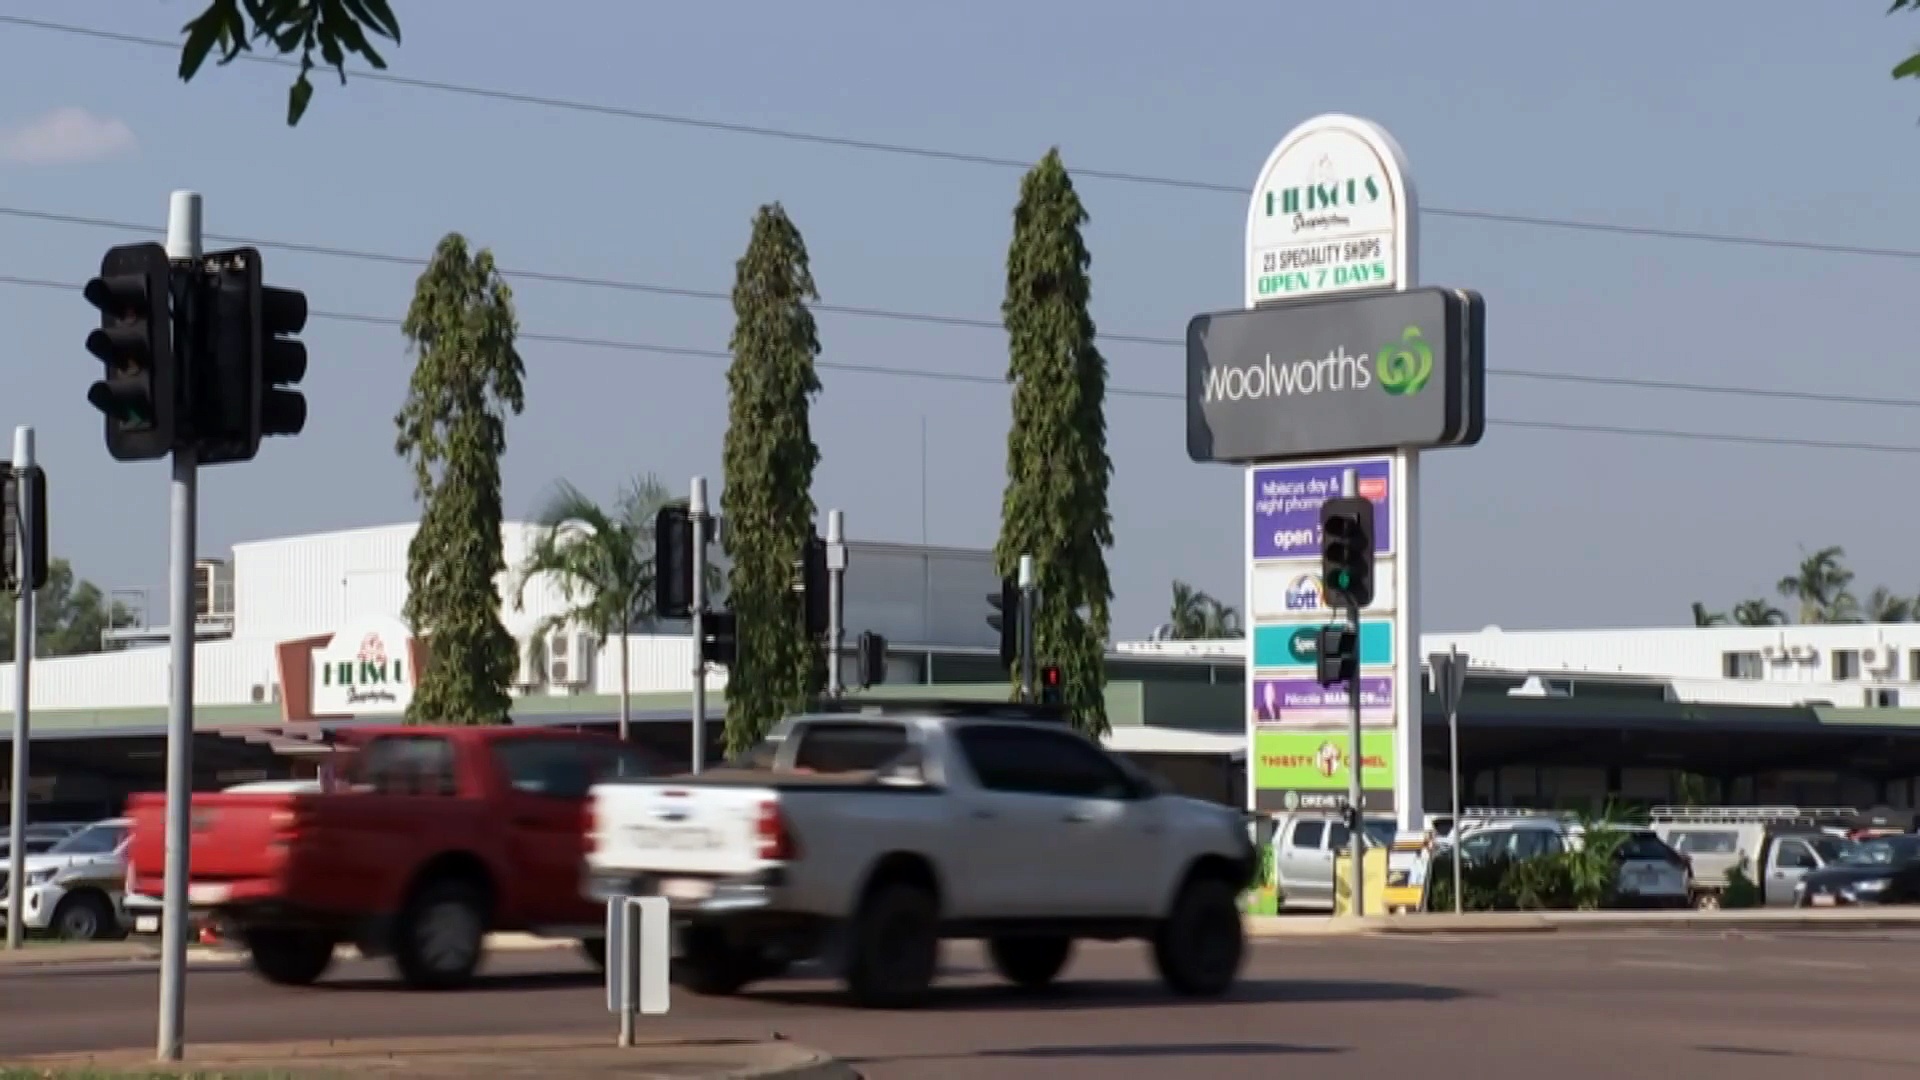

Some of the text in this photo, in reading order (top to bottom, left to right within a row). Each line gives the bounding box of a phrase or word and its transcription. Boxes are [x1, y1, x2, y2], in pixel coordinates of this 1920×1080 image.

[1266, 176, 1379, 217] HIBISCUS
[1344, 237, 1380, 262] SHOPS
[1258, 261, 1385, 294] OPEN 7 DAYS
[1307, 477, 1328, 497] day
[1330, 476, 1339, 492] &
[1255, 498, 1283, 516] night
[1274, 530, 1313, 550] open
[1260, 755, 1386, 769] THIRSTY CMEL
